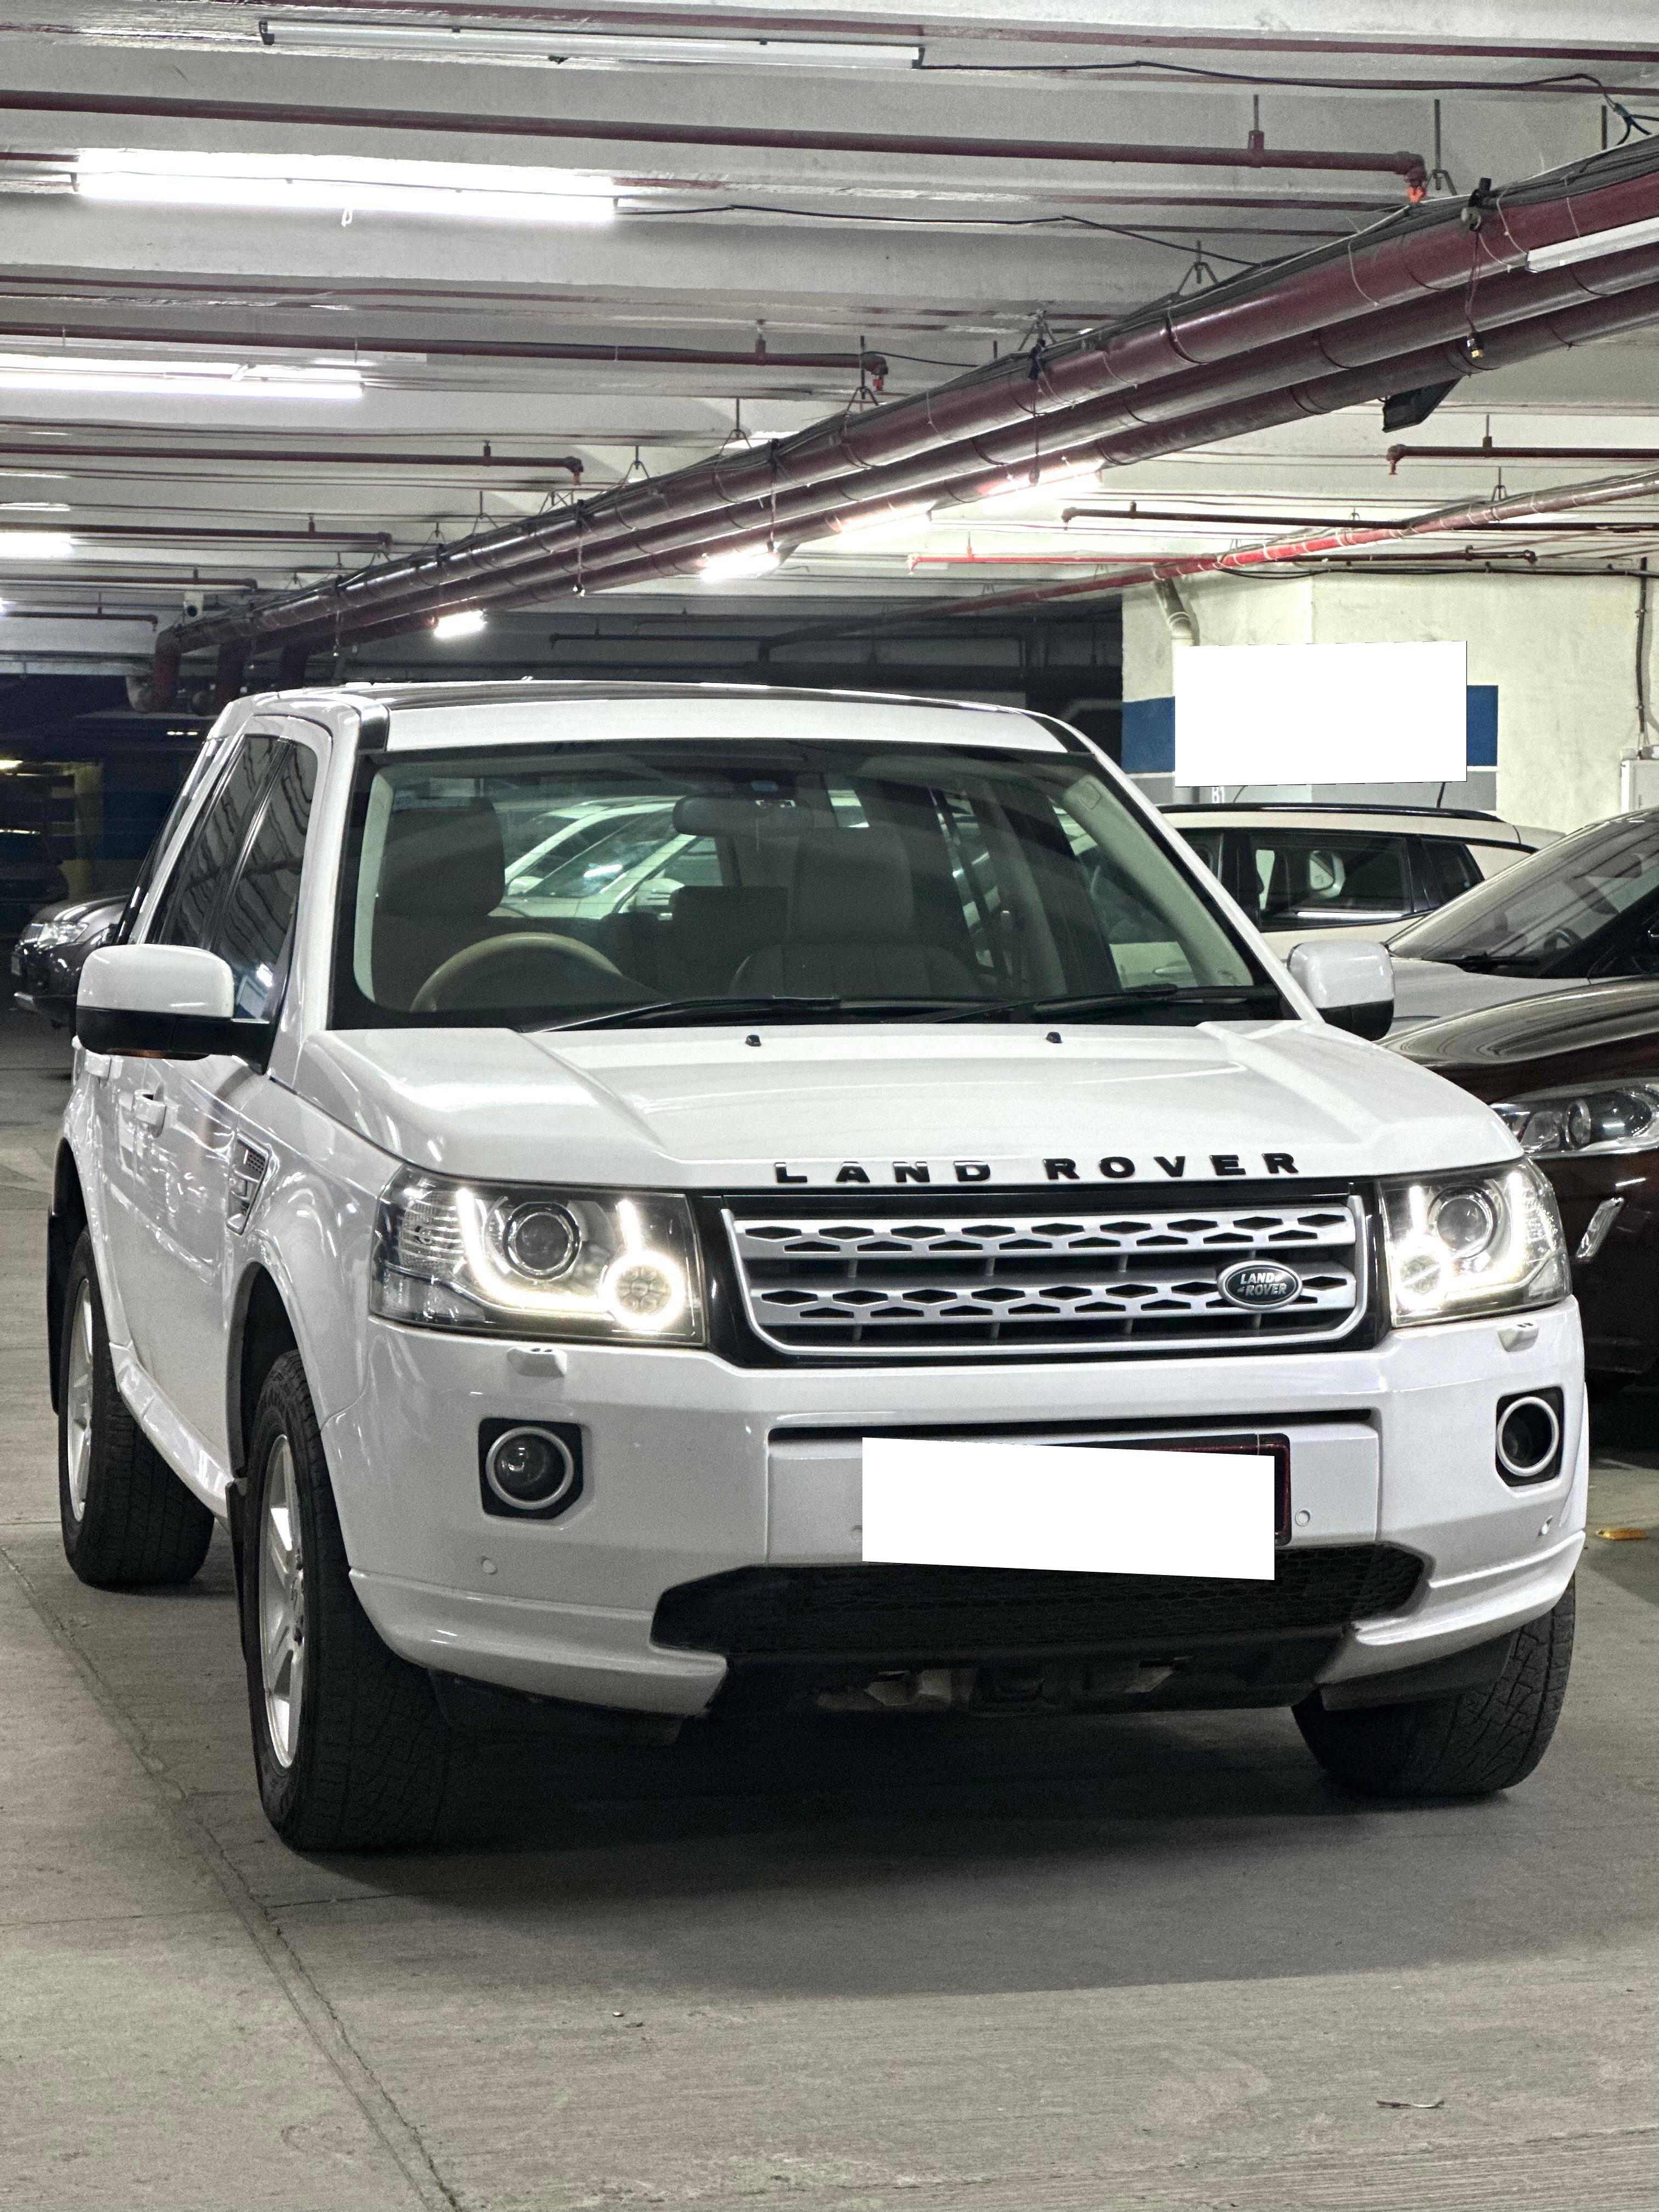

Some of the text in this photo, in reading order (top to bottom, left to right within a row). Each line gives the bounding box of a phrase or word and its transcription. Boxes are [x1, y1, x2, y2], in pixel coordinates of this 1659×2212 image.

[774, 1152, 1299, 1183] LAND ROVER
[1240, 1272, 1275, 1284] LAND
[1245, 1283, 1287, 1296] ROVER
